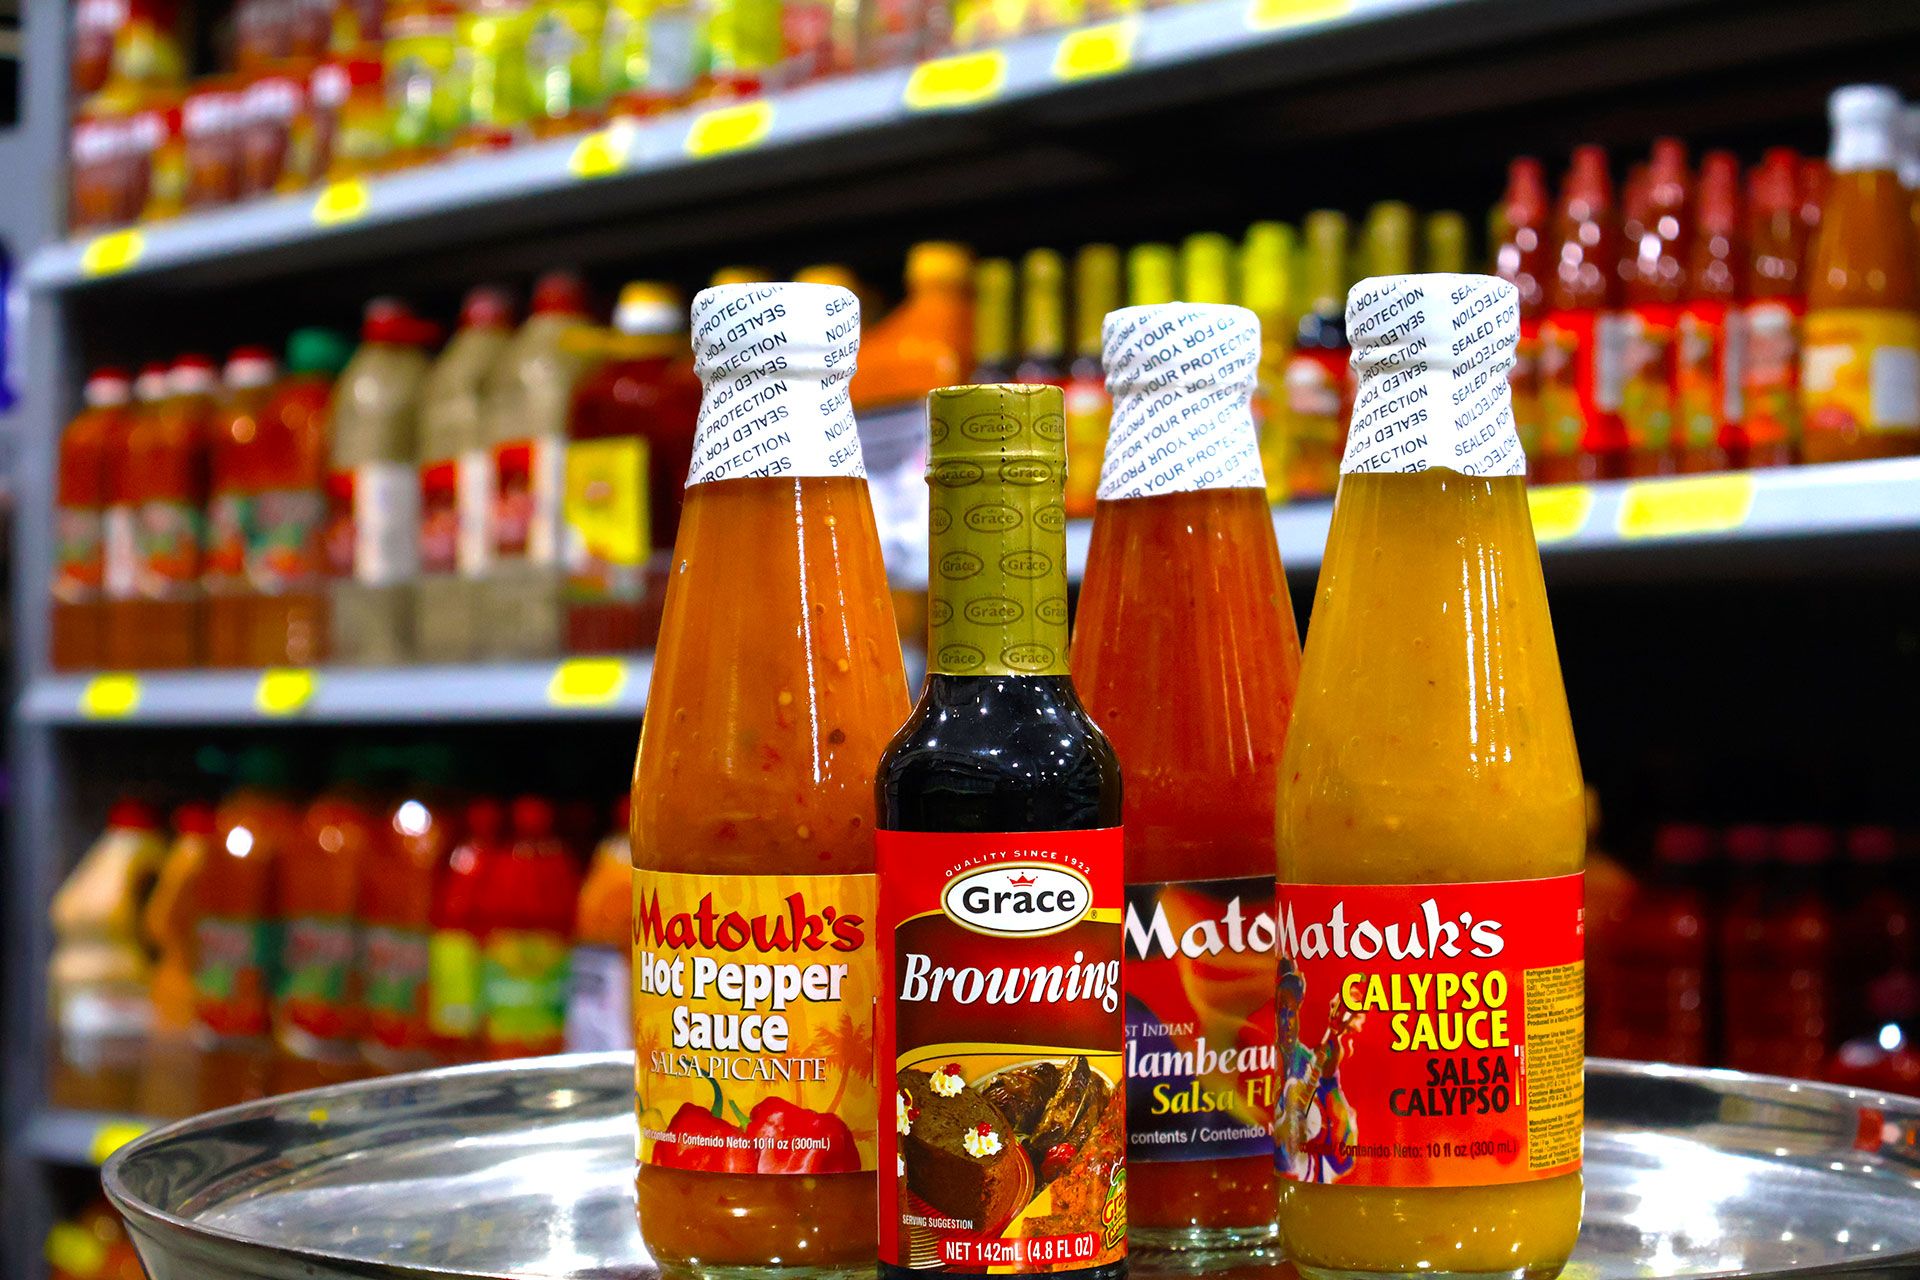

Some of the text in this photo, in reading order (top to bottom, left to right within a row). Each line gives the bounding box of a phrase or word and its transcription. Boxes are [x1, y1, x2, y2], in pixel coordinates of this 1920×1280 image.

[727, 304, 786, 342] SEALED
[1354, 287, 1424, 341] PROTECTION
[1380, 311, 1425, 346] SEALED
[1135, 322, 1176, 351] YOUR
[1452, 305, 1515, 356] SEALED FOR
[710, 331, 787, 386] PROTECTION
[1142, 344, 1182, 372] YOUR
[735, 356, 787, 392] SEALED
[1143, 374, 1179, 396] YOUR
[1383, 361, 1428, 393] SEALED
[1452, 358, 1512, 406] SEALED FOR
[706, 380, 787, 439] PROTECTION
[713, 386, 733, 410] FOR
[1147, 389, 1183, 418] YOUR
[1354, 385, 1428, 438] PROTECTION
[733, 406, 788, 442] SEALED
[969, 422, 1013, 434] Grace
[1144, 415, 1180, 443] YOUR
[1375, 409, 1428, 443] SEALED
[706, 437, 729, 461] FOR
[1148, 437, 1187, 467] YOUR
[1455, 424, 1496, 456] SEALED
[1008, 469, 1047, 479] Grace
[1144, 463, 1185, 491] YOUR
[971, 513, 1014, 525] Grace
[943, 560, 1046, 572] Grace Grace
[971, 606, 1016, 618] Grace
[941, 652, 1049, 665] Grace Grace
[945, 850, 1091, 877] QUALITY SINCE 1922
[962, 886, 1075, 914] Grace
[633, 887, 865, 953] Matouk's
[1275, 897, 1505, 960] Matouk's
[641, 951, 848, 1011] Hot Pepper
[900, 950, 1120, 1014] Browning
[1342, 970, 1509, 1012] CALYPSO
[672, 1005, 789, 1054] Sauce
[1142, 1022, 1193, 1037] INDIAN
[1391, 1010, 1510, 1051] SAUCE
[651, 1050, 827, 1082] SALSA PICANTE
[1426, 1056, 1510, 1087] SALSA
[1151, 1081, 1234, 1115] Salsa
[1389, 1086, 1510, 1117] CALYPSO
[682, 1133, 724, 1149] Contenido
[726, 1137, 751, 1149] Neto:
[753, 1137, 767, 1149] 10
[768, 1138, 775, 1149] fl
[777, 1141, 788, 1150] oz
[791, 1138, 831, 1152] (300mL)
[1131, 1128, 1188, 1144] contents
[1200, 1124, 1265, 1143] Contenido
[1393, 1143, 1422, 1158] Neto:
[1426, 1143, 1441, 1158] 10
[1443, 1142, 1451, 1157] fl
[1454, 1144, 1467, 1157] oz
[1469, 1141, 1494, 1160] (300
[903, 1214, 973, 1230] SERVING SUGGESTION
[945, 1235, 1094, 1263] NET 142mL (4.8 FL OZ)
